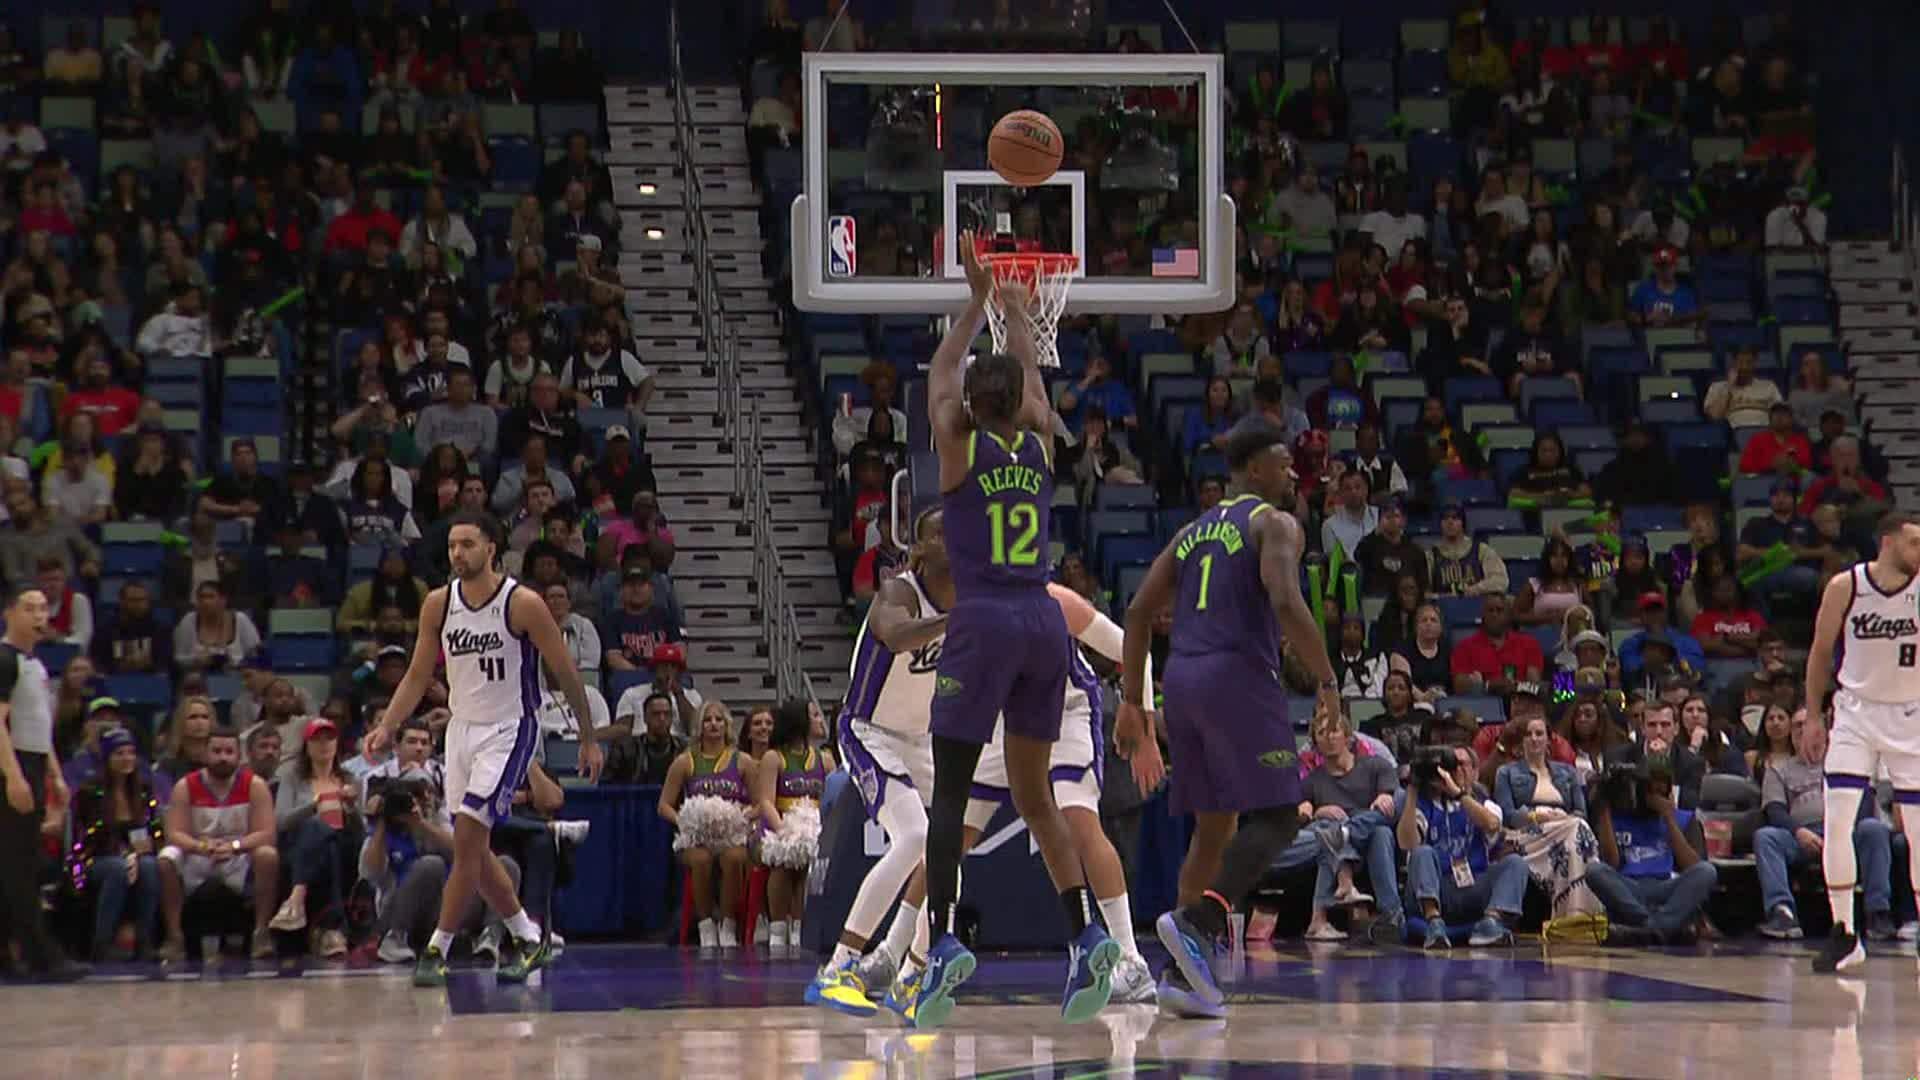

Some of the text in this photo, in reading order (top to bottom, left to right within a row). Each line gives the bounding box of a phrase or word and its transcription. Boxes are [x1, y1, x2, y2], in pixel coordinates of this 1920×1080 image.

[978, 465, 1042, 496] REEVES
[986, 502, 1039, 565] 12
[1197, 553, 1212, 609] 1
[1851, 612, 1918, 640] Kings
[446, 628, 504, 656] Kings
[1899, 643, 1917, 668] 8
[479, 657, 505, 681] 41
